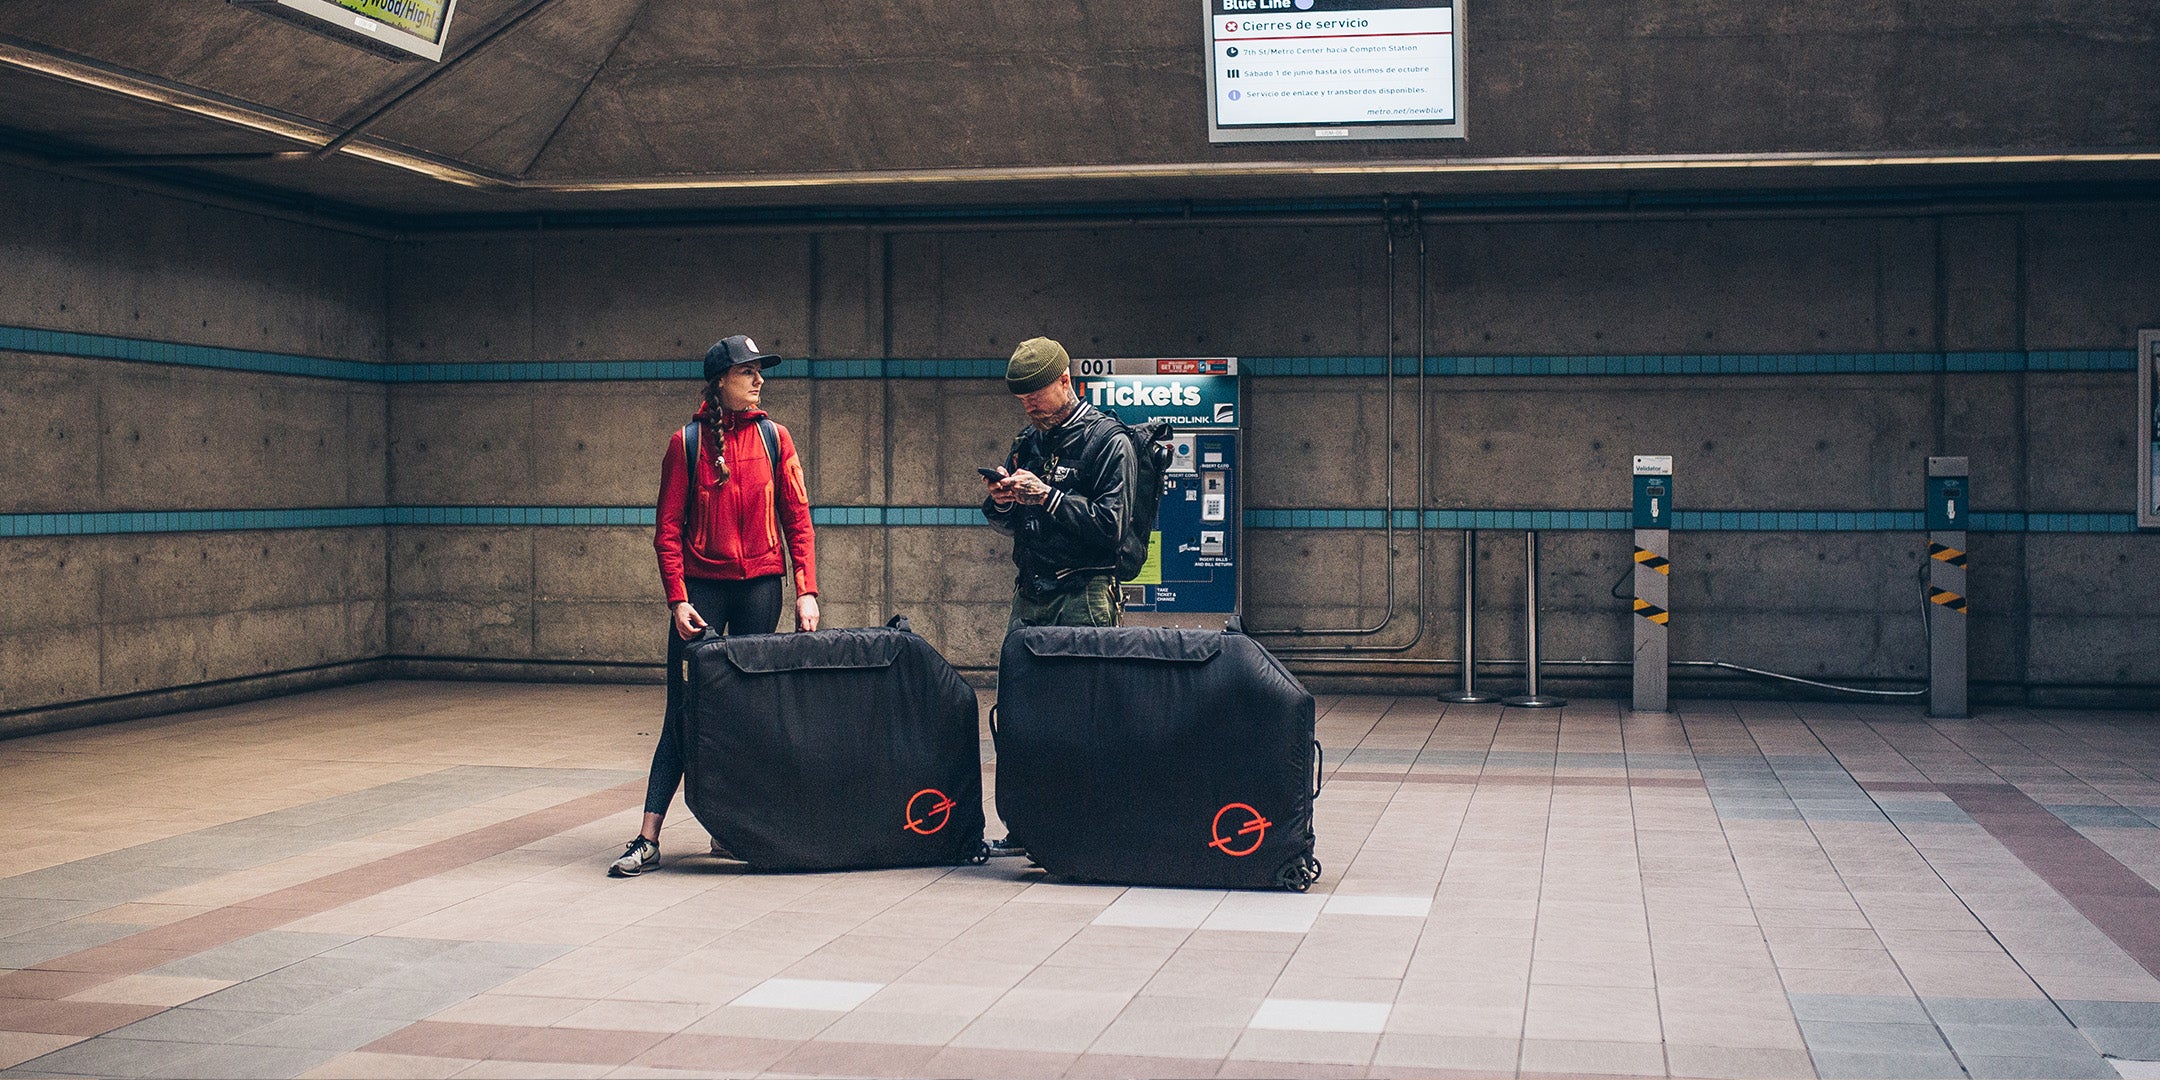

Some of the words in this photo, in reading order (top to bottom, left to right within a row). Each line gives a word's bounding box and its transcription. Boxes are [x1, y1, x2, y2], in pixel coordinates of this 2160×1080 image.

[1223, 0, 1256, 10] Blue
[1260, 0, 1291, 9] Line
[1243, 21, 1292, 31] Cierres
[1296, 20, 1311, 30] de
[1316, 18, 1369, 29] servicio
[1259, 48, 1294, 56] St/Metro
[1297, 47, 1323, 55] Center
[1349, 45, 1387, 53] Compton
[1388, 44, 1418, 52] Station
[1293, 69, 1314, 77] junio
[1246, 90, 1279, 98] Servicio
[1327, 88, 1376, 96] transbordos
[1367, 107, 1444, 115] metro.net/newblue
[1081, 360, 1113, 375] 001
[1087, 381, 1201, 406] Tickets
